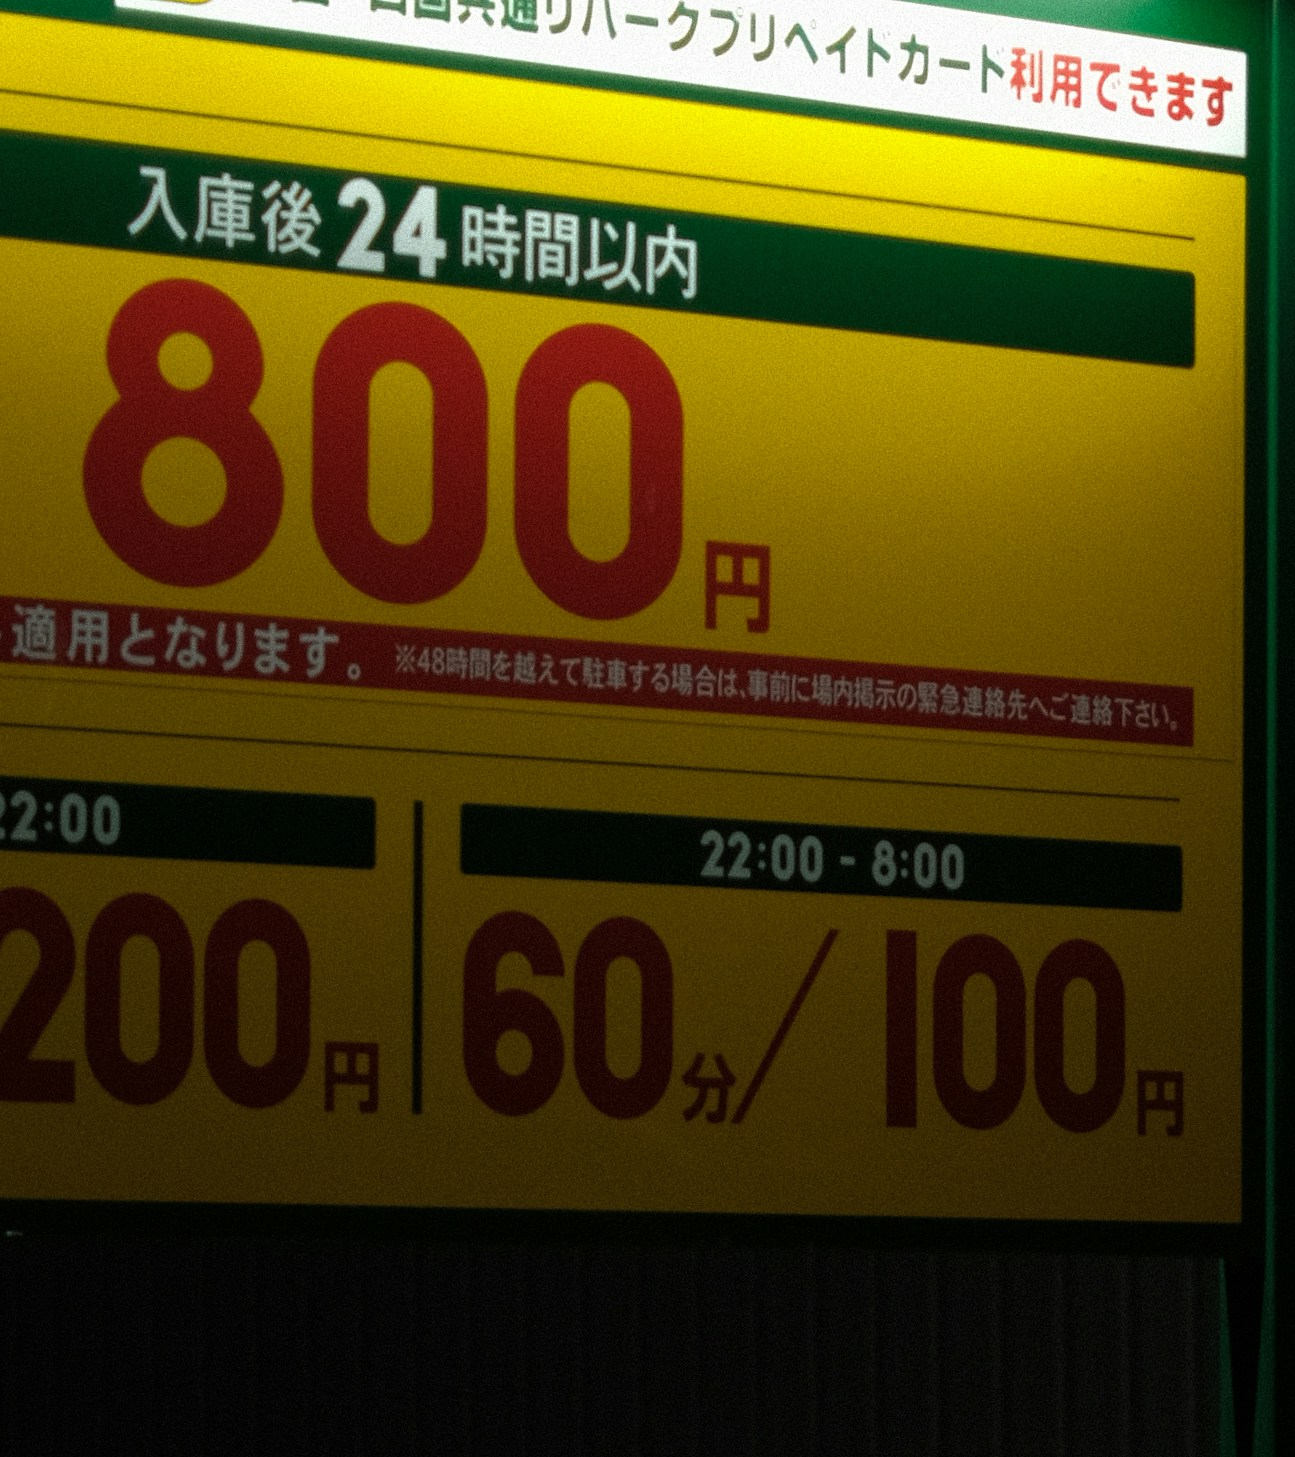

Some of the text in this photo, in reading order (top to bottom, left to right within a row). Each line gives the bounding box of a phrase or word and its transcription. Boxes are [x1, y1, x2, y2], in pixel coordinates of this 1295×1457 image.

[127, 165, 698, 300] 入庫後24時間以内
[83, 277, 771, 634] 800円
[11, 602, 362, 681] 適用となります。
[0, 788, 122, 846] 2:00
[701, 830, 823, 883] 22:00
[871, 840, 965, 890] 8:00
